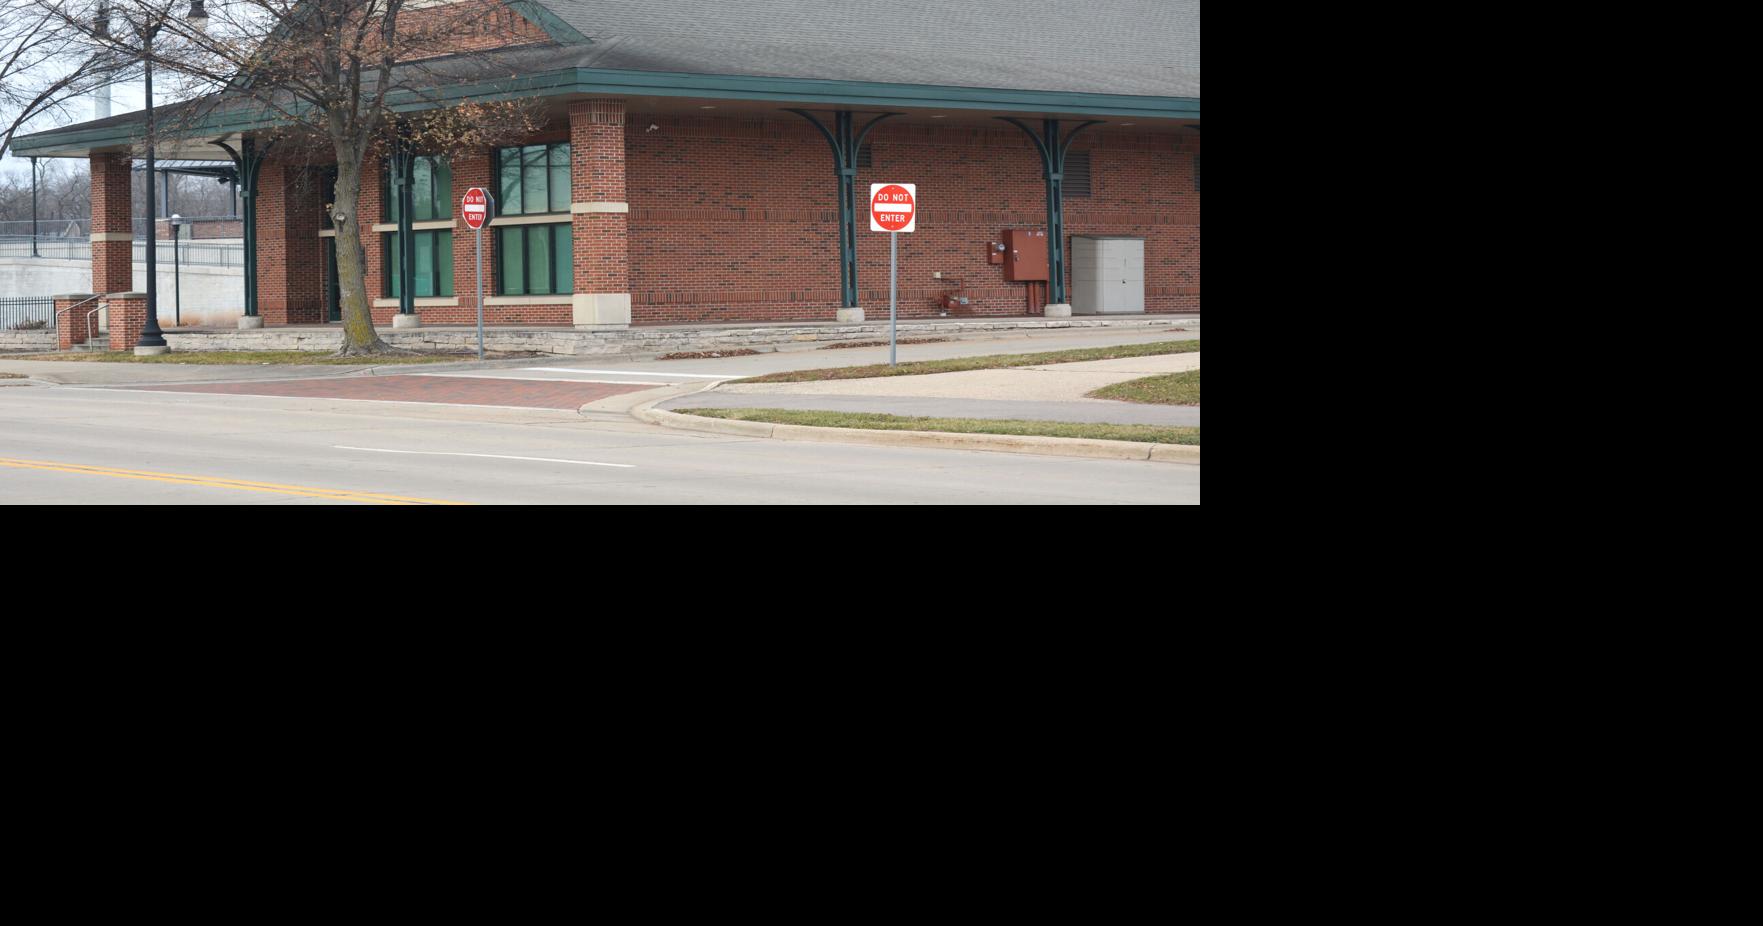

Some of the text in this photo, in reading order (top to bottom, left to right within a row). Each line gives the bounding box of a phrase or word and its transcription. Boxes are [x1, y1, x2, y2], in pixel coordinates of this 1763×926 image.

[466, 195, 474, 203] DO
[878, 193, 909, 202] DO NOT
[880, 214, 905, 222] ENTER
